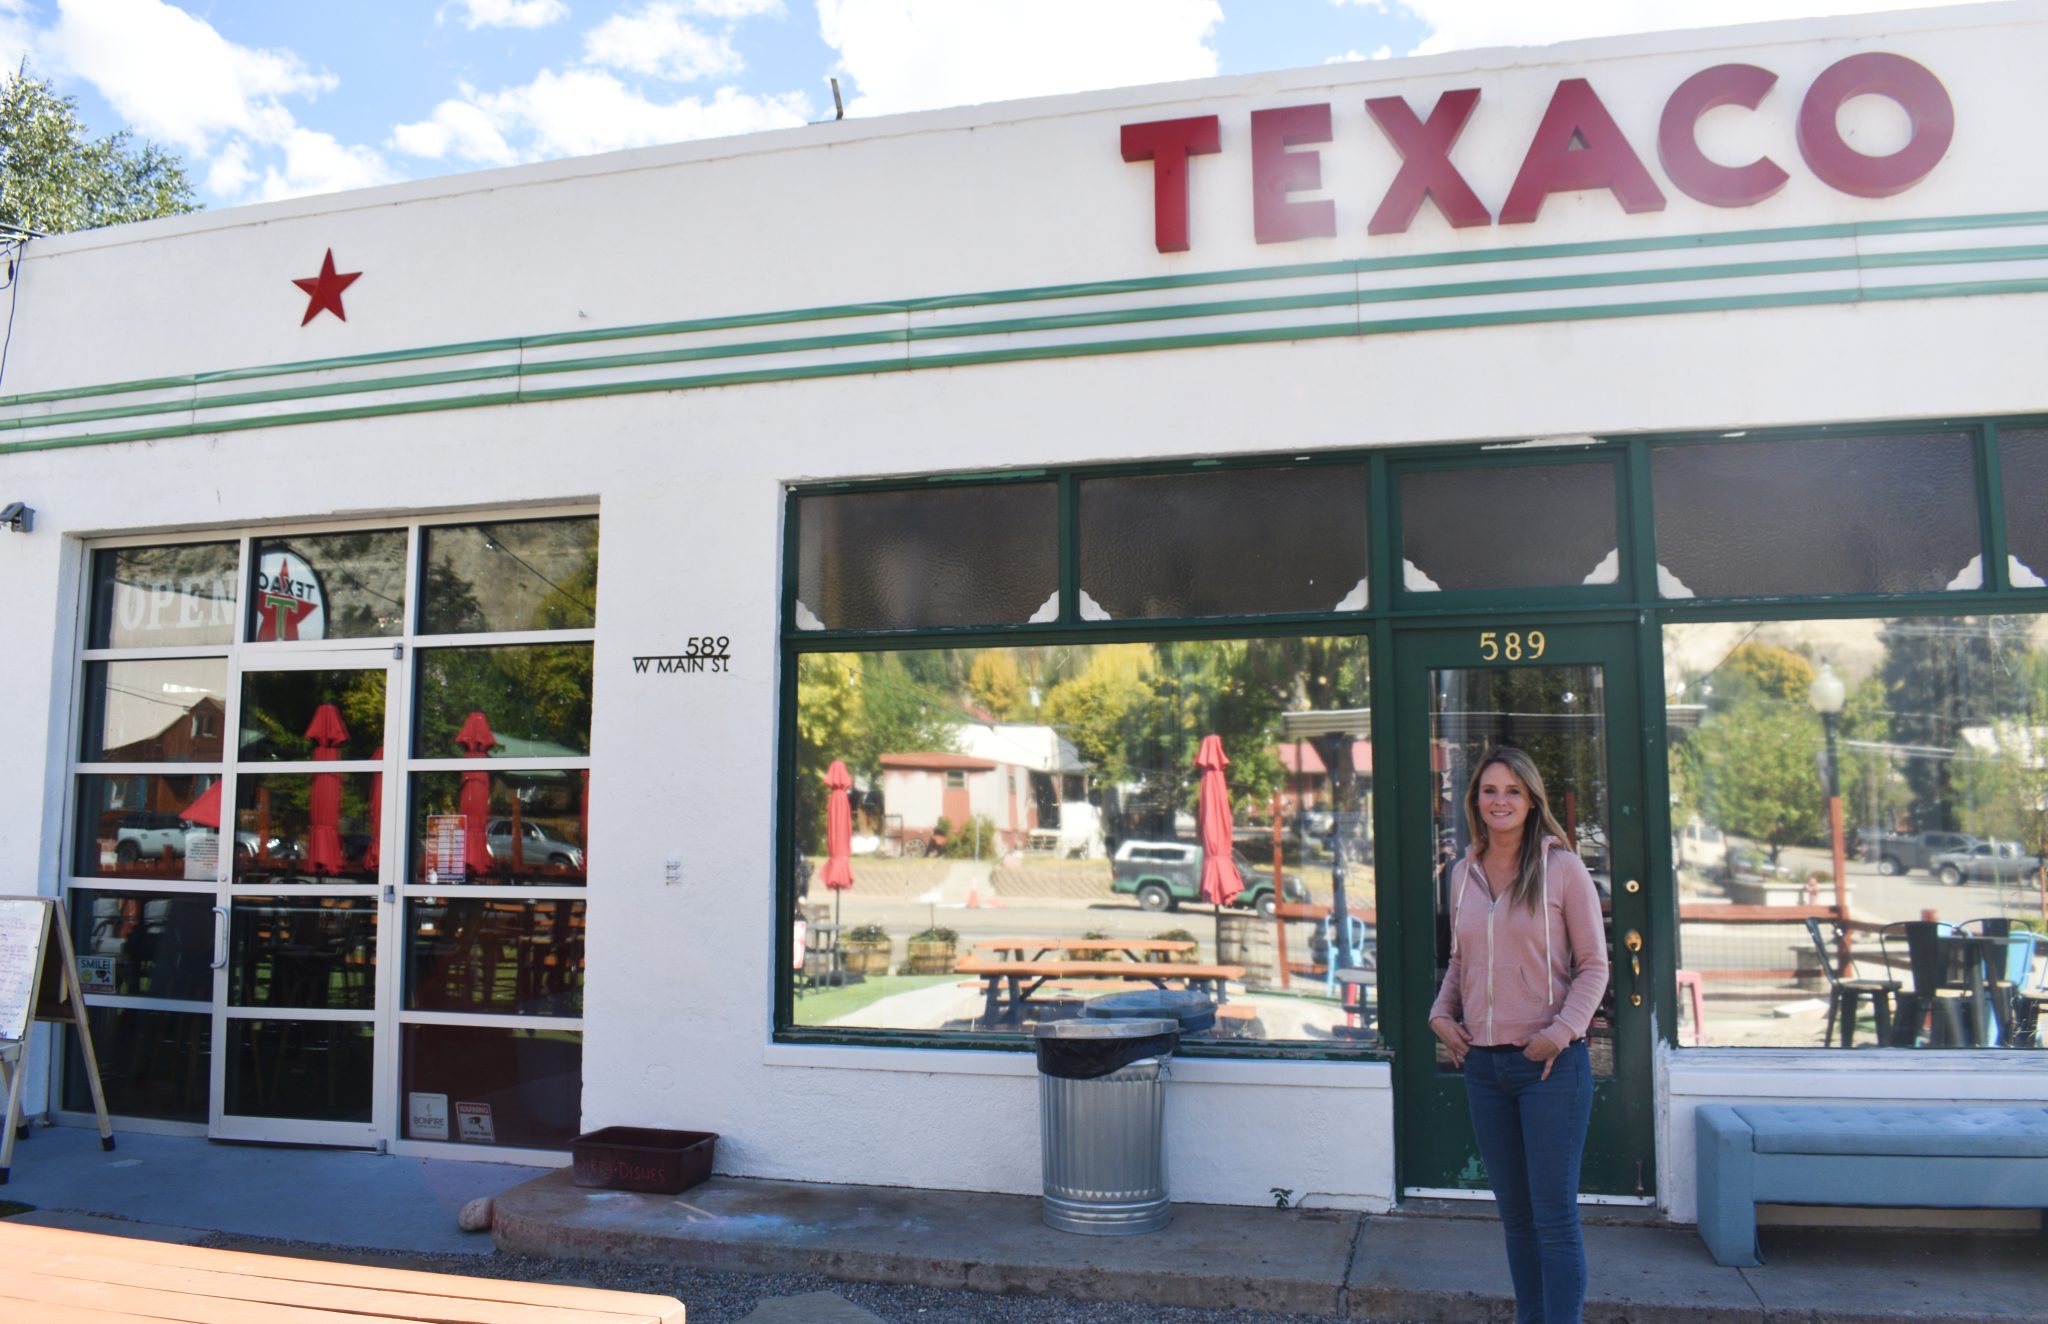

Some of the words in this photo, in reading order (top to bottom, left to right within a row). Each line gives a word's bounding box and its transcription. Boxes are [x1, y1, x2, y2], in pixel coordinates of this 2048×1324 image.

[1121, 51, 1955, 254] TEXACO
[117, 571, 236, 632] OPEN
[685, 636, 729, 657] 589
[1480, 630, 1545, 661] 589
[633, 657, 650, 673] W
[657, 657, 704, 673] MAIN
